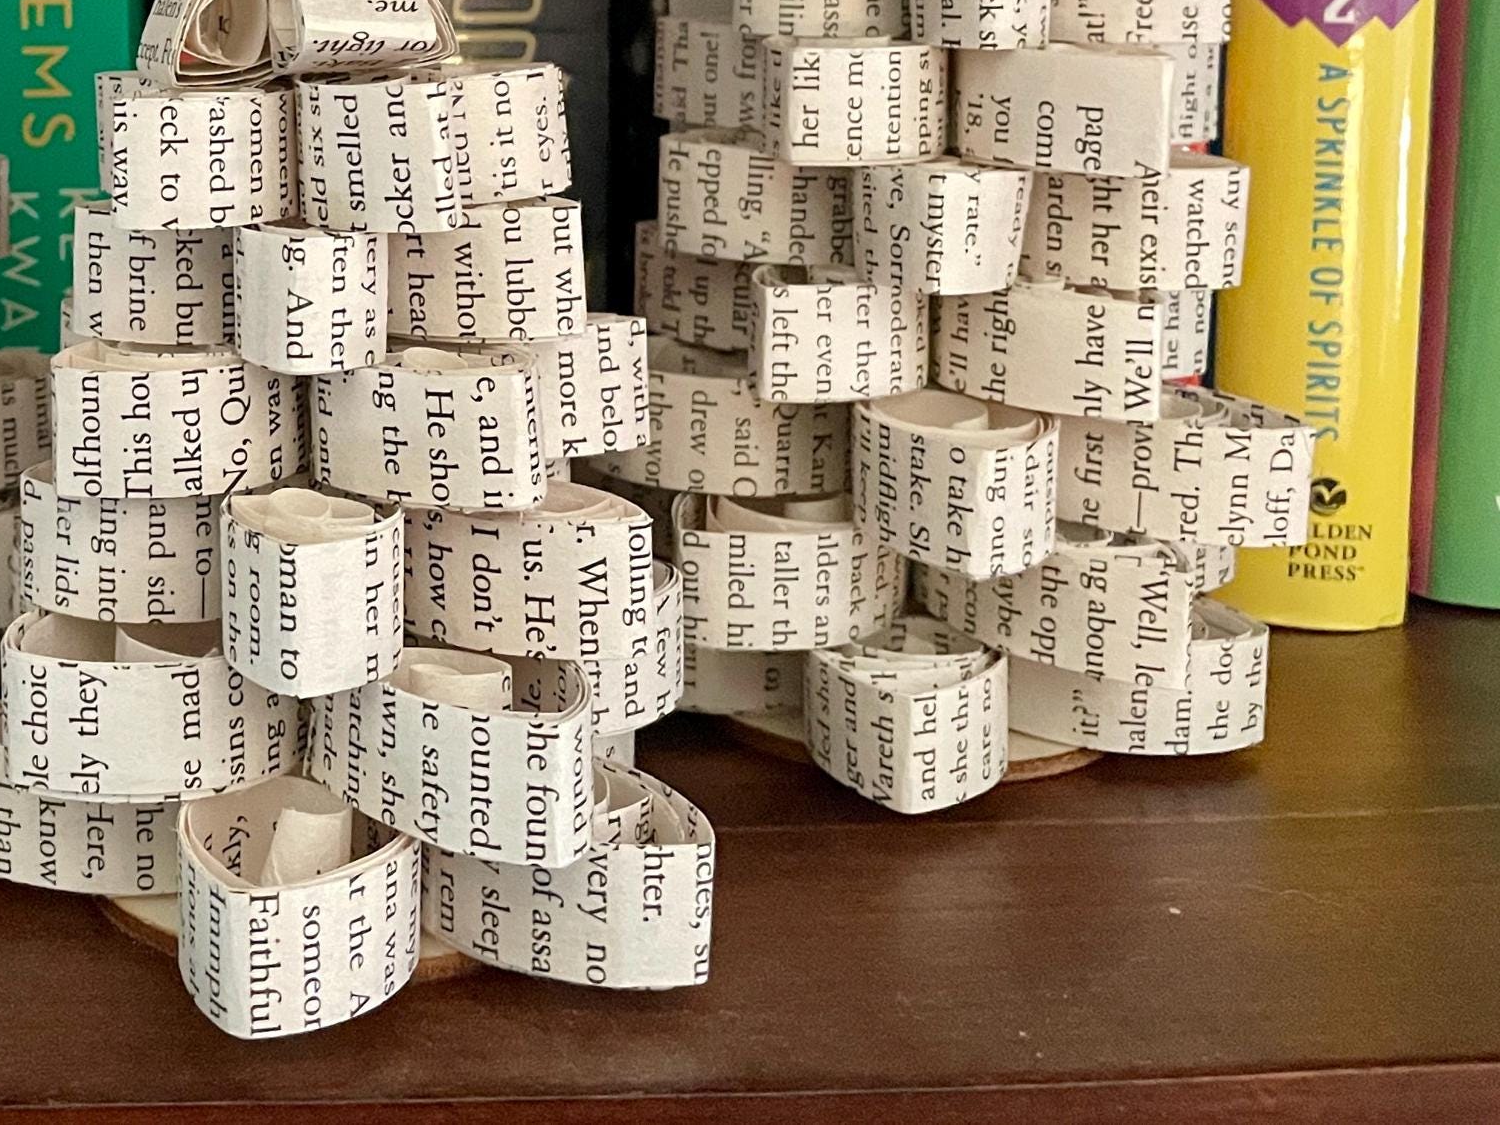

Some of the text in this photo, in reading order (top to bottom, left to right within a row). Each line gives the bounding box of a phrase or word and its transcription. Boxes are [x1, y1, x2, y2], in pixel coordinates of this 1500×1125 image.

[366, 0, 419, 15] me.
[791, 103, 821, 149] her
[990, 95, 1012, 145] you
[1074, 105, 1106, 183] page,
[335, 93, 367, 212] smelled
[160, 170, 180, 203] to
[1, 190, 41, 332] KWA
[87, 231, 112, 295] then
[1091, 215, 1123, 261] her
[1304, 63, 1350, 443] A SPRINKLE OF SPIRITS
[129, 254, 158, 332] brine
[286, 291, 314, 360] And
[771, 306, 801, 399] left the
[1074, 304, 1106, 368] have
[558, 350, 578, 428] more
[632, 350, 649, 425] with
[849, 339, 879, 397] they
[1123, 338, 1155, 411] We'll
[267, 378, 281, 440] was
[424, 388, 456, 439] He
[689, 391, 718, 456] drew
[122, 431, 154, 498] This
[381, 424, 409, 475] the
[479, 416, 513, 486] and
[733, 416, 760, 467] said
[908, 433, 933, 511] stake.
[1074, 433, 1105, 487] first
[947, 476, 976, 538] take
[428, 540, 454, 607] how
[471, 552, 504, 632] don't
[772, 540, 801, 612] taller
[1040, 565, 1070, 608] the
[247, 572, 262, 666] room.
[365, 583, 385, 636] her
[280, 648, 299, 681] to
[1245, 646, 1264, 690] the
[69, 671, 109, 737] they
[1207, 695, 1233, 742] the
[572, 724, 590, 841] would
[920, 747, 939, 802] and
[949, 739, 970, 792] she
[980, 728, 993, 780] care
[412, 745, 450, 845] safety
[38, 798, 67, 887] know
[249, 892, 282, 1037] Faithful
[348, 913, 373, 971] the
[586, 943, 607, 984] no
